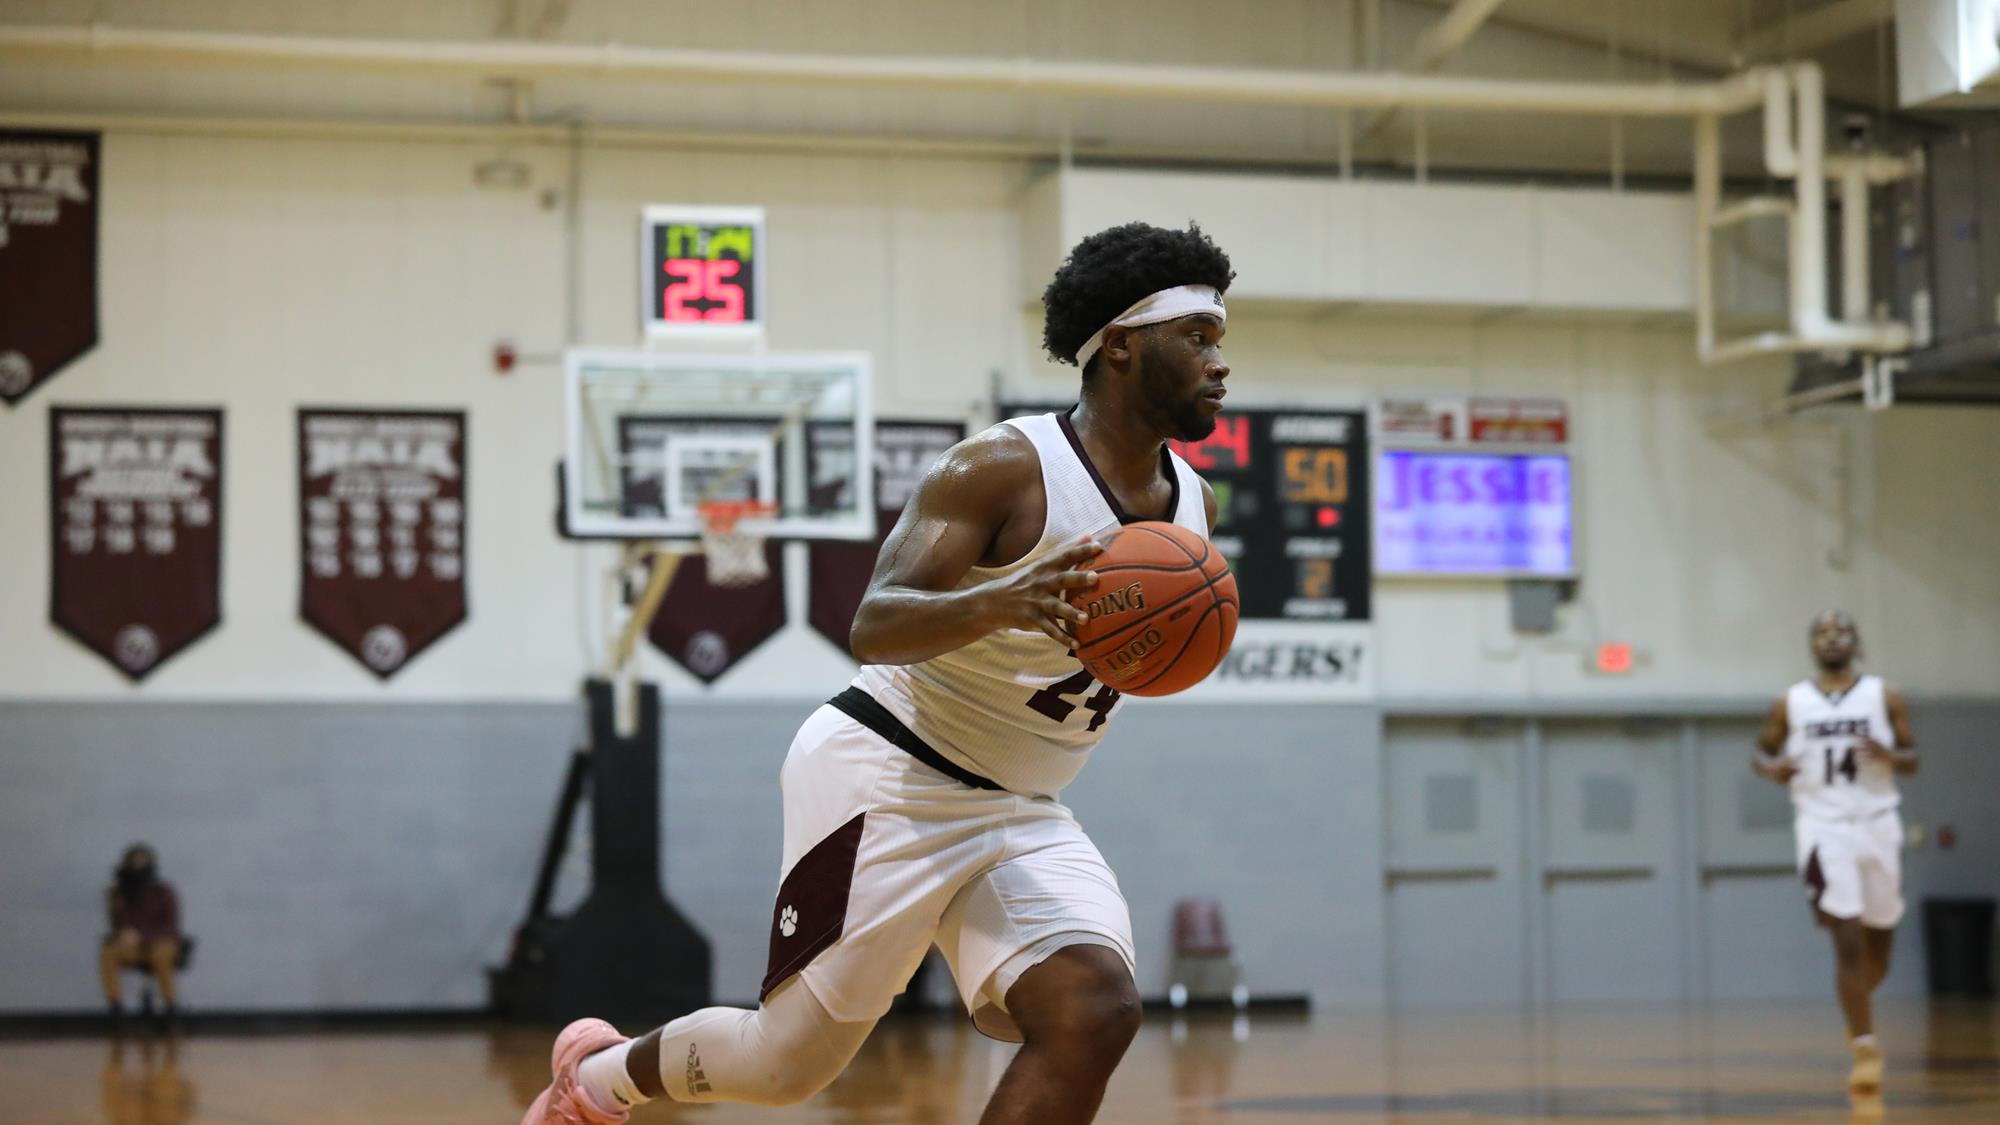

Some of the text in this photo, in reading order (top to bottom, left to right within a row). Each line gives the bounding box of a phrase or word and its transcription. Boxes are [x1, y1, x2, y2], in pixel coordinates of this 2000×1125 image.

[0, 163, 90, 202] AIA
[663, 258, 745, 324] 25
[62, 438, 214, 480] NAIA
[306, 438, 459, 481] NAIA
[1284, 448, 1349, 503] 50
[1088, 580, 1145, 620] DING
[1104, 628, 1162, 671] 1000
[1219, 638, 1366, 685] IGERS!
[1025, 666, 1120, 732] 24
[1824, 746, 1858, 786] 14
